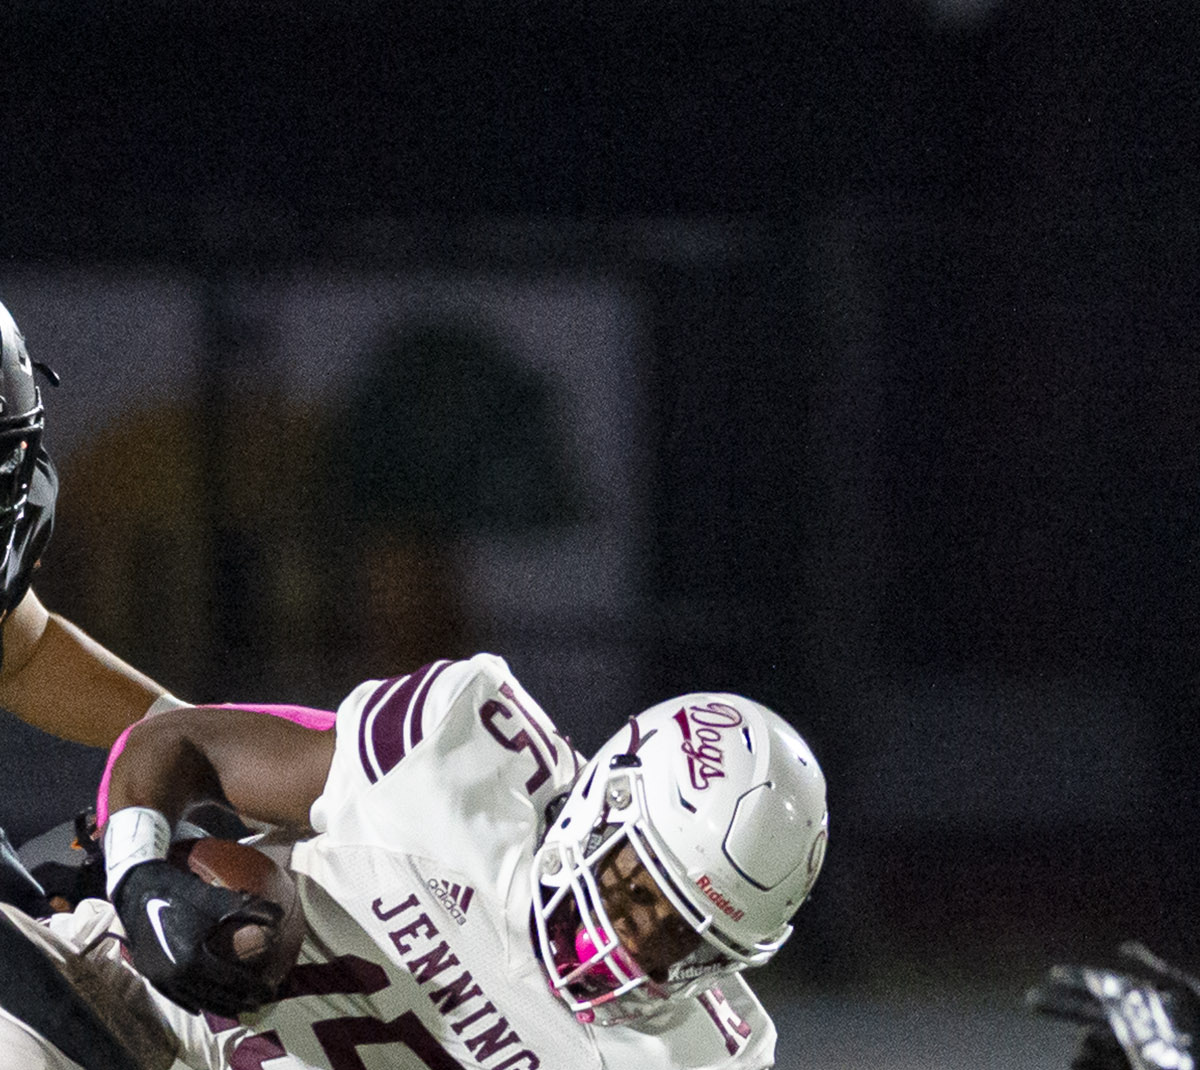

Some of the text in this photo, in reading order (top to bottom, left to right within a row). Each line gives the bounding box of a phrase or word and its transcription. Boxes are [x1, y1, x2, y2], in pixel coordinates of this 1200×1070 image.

[679, 703, 743, 785] Dogs
[427, 878, 467, 926] adidas
[696, 875, 745, 923] Riddell
